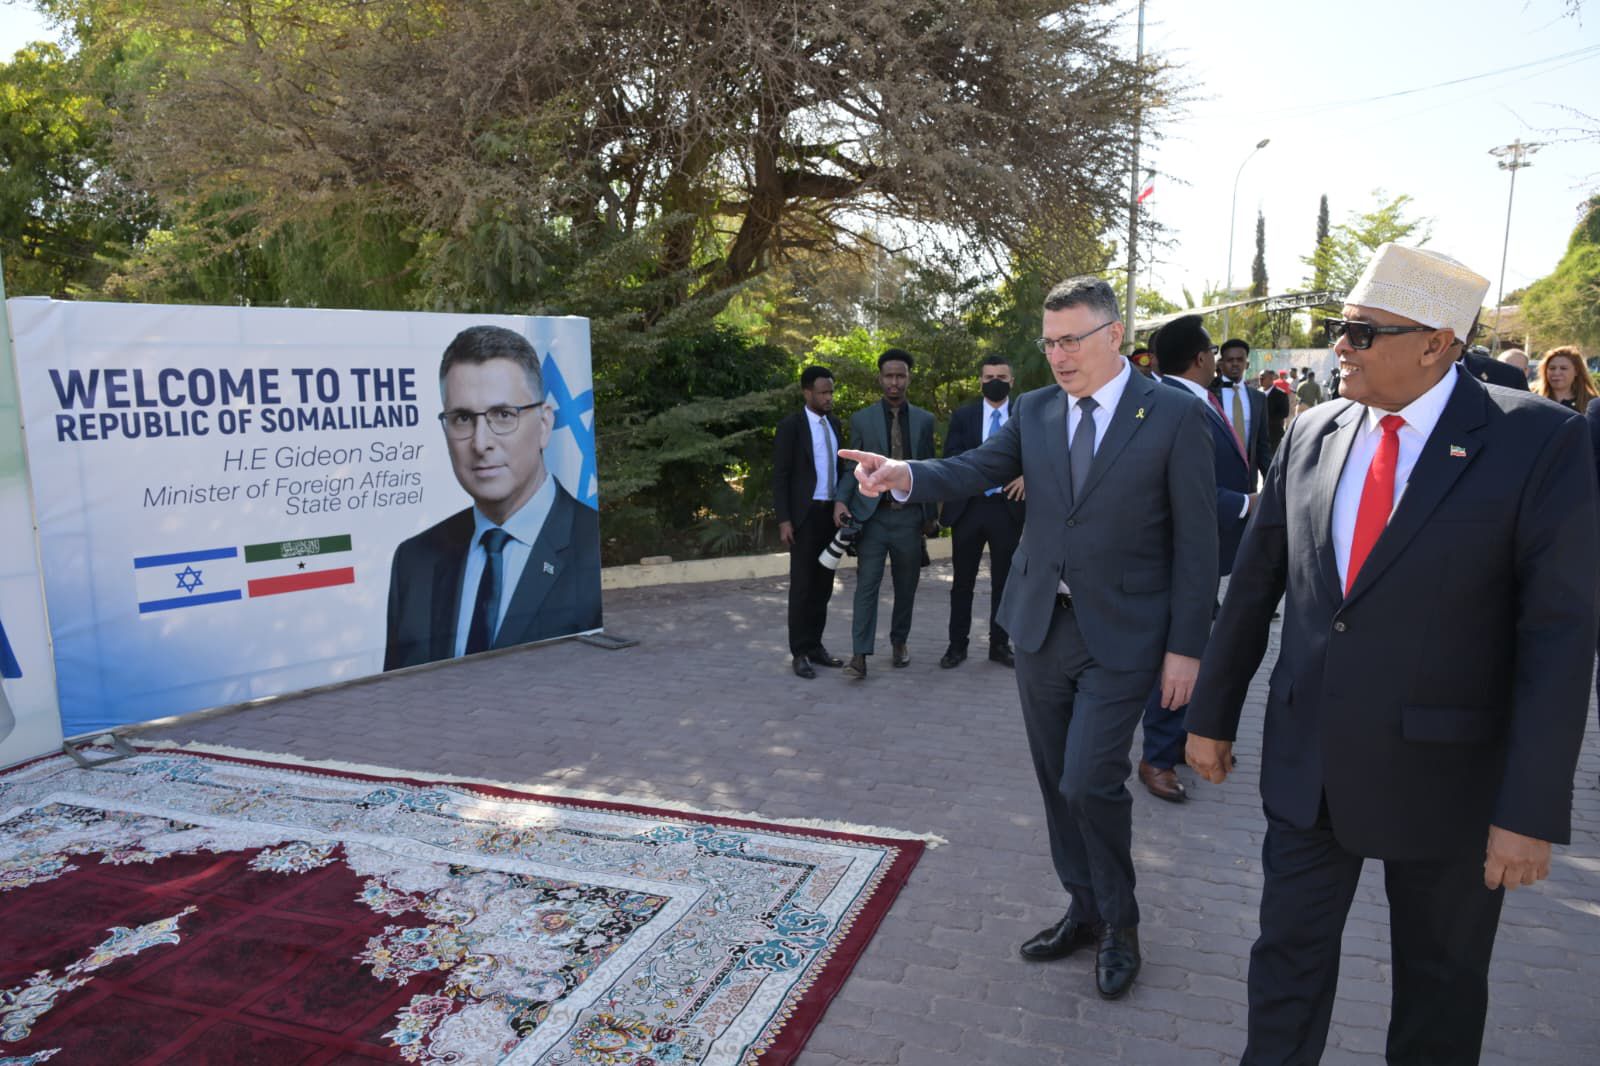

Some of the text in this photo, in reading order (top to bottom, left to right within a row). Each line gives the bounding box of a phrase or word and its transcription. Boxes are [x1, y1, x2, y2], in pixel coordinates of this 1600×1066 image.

[48, 367, 418, 409] WELCOME TO THE
[55, 404, 419, 442] REPUBLIC OF SOMALILAND
[223, 441, 424, 472] H.E Gideon Sa'ar
[143, 469, 422, 508] Minister of Foreign Affairs
[285, 487, 424, 516] State of Israel
